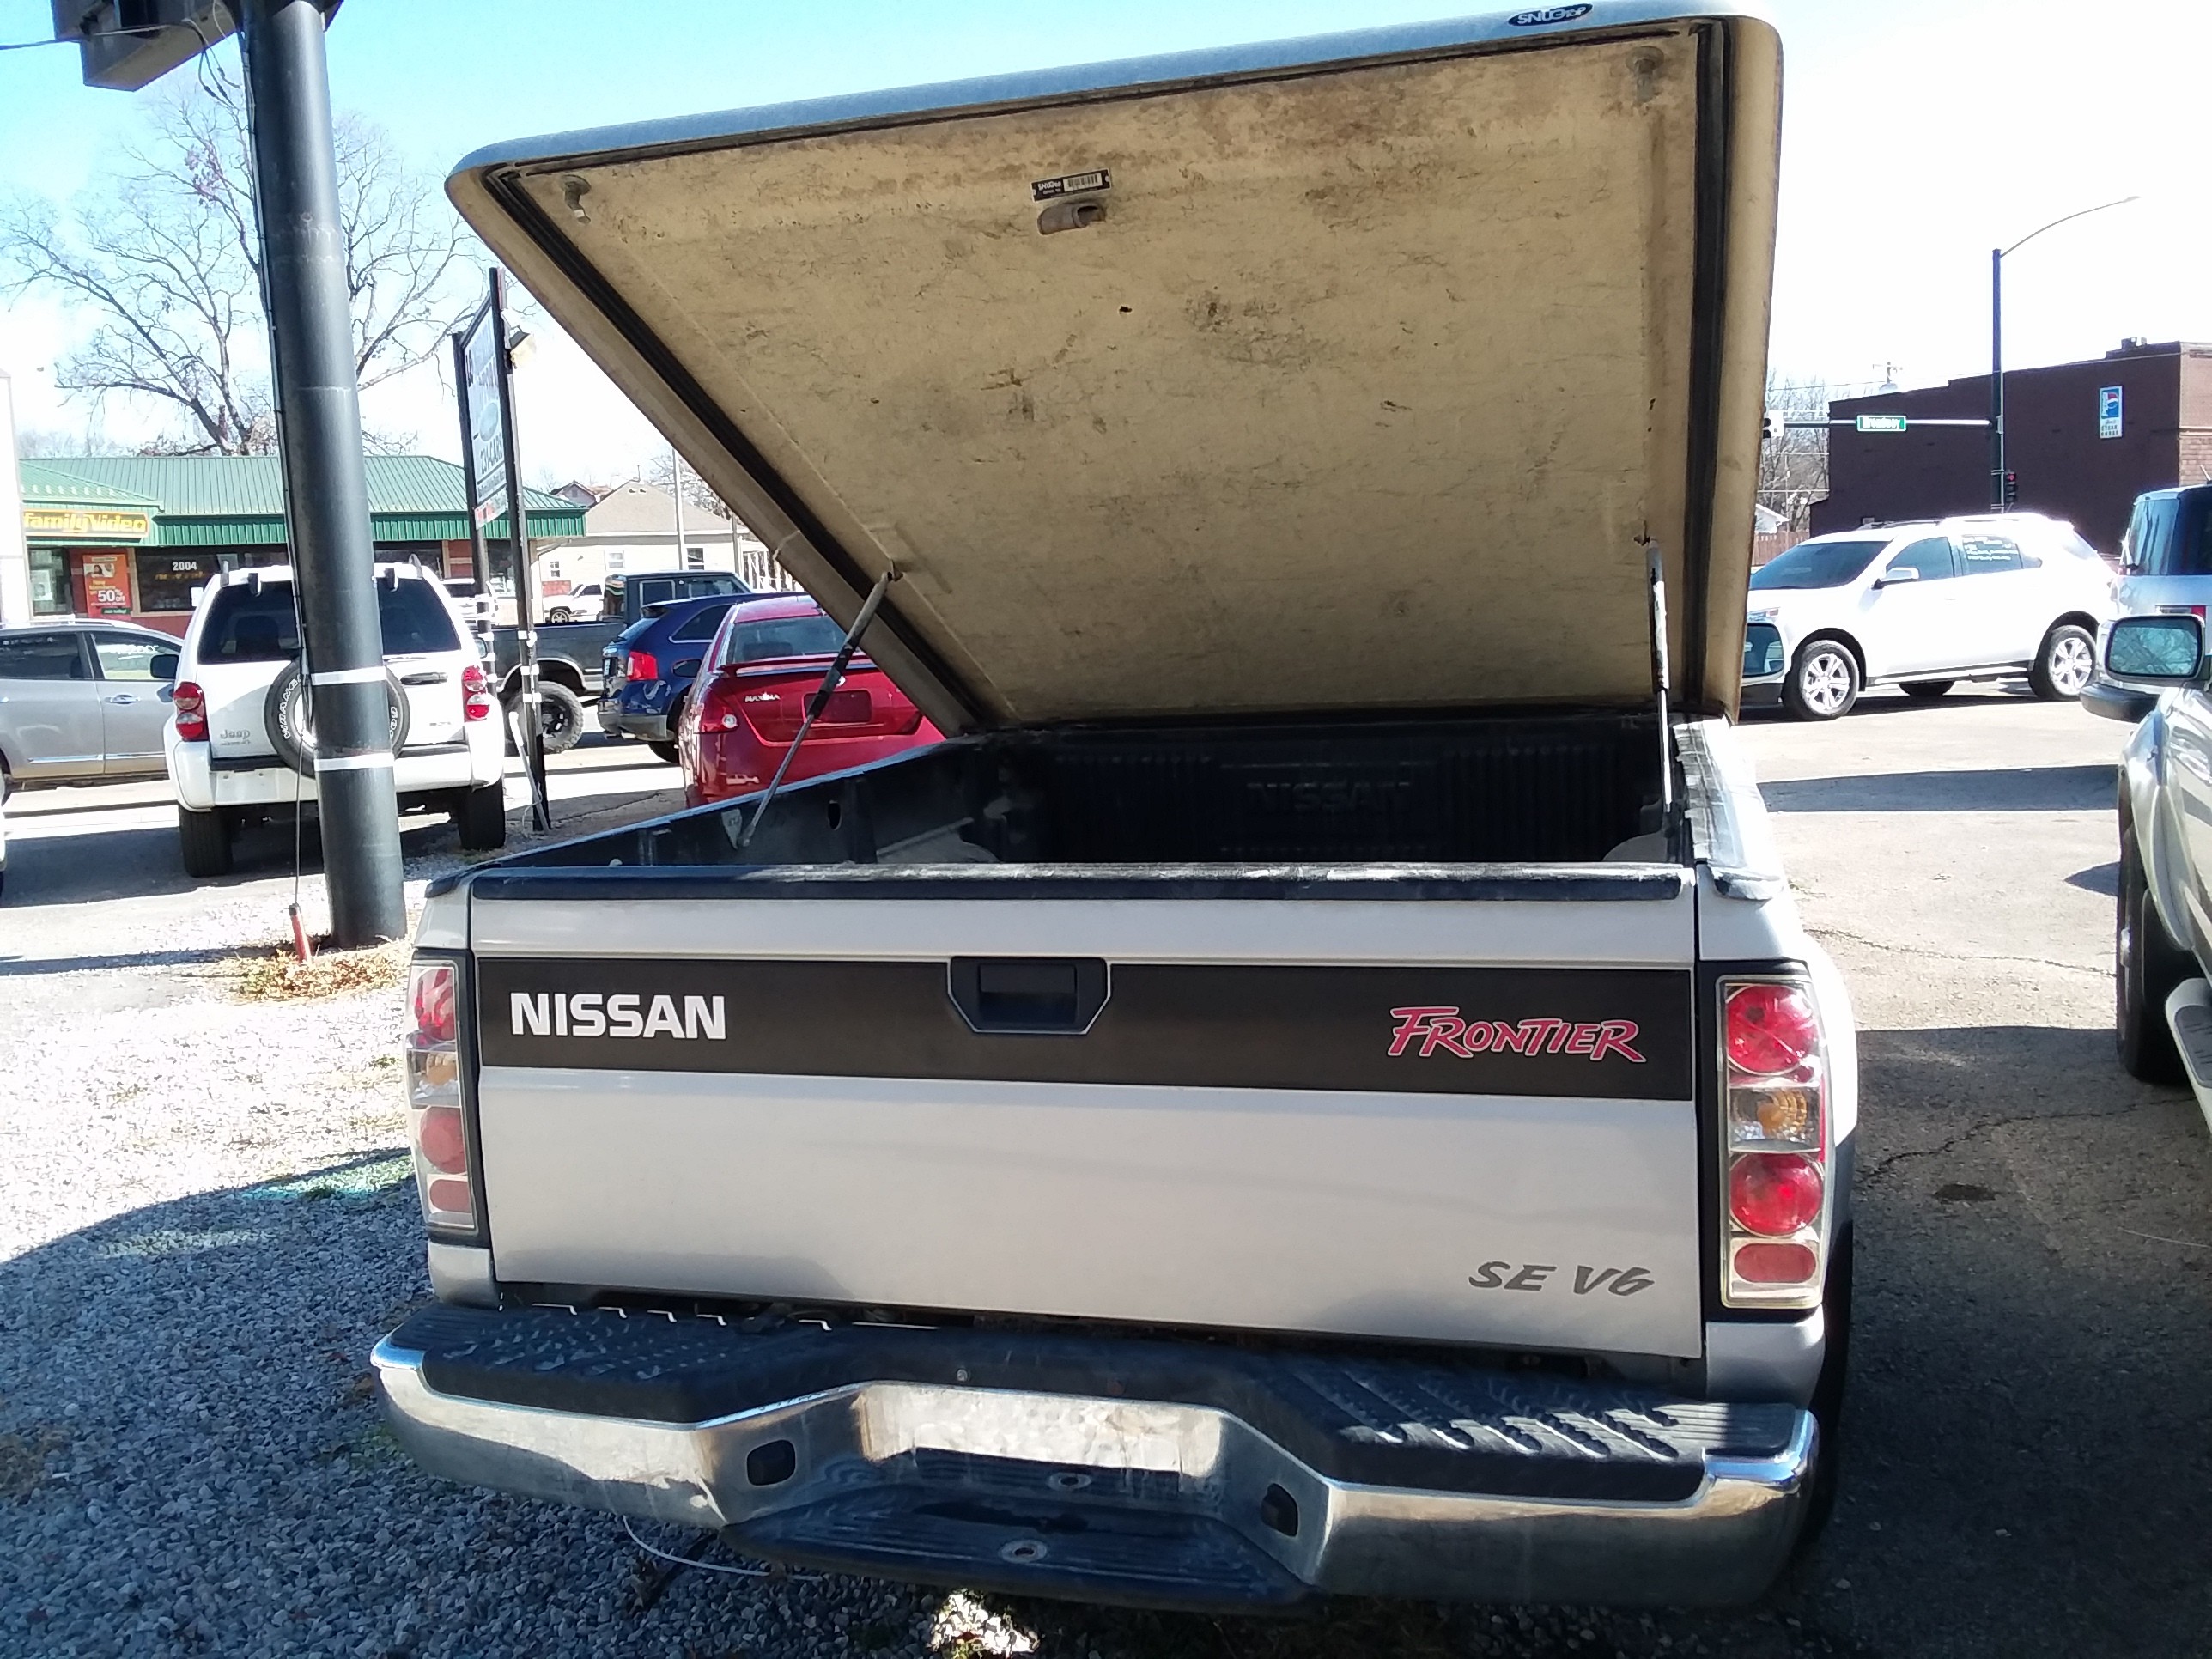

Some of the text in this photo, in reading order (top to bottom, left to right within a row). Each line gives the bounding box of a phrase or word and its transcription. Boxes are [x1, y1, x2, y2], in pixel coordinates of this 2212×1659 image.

[172, 561, 198, 571] 2004
[220, 729, 251, 739] Jeep
[510, 992, 726, 1040] NISSAN
[1468, 1261, 1655, 1296] SE V6
